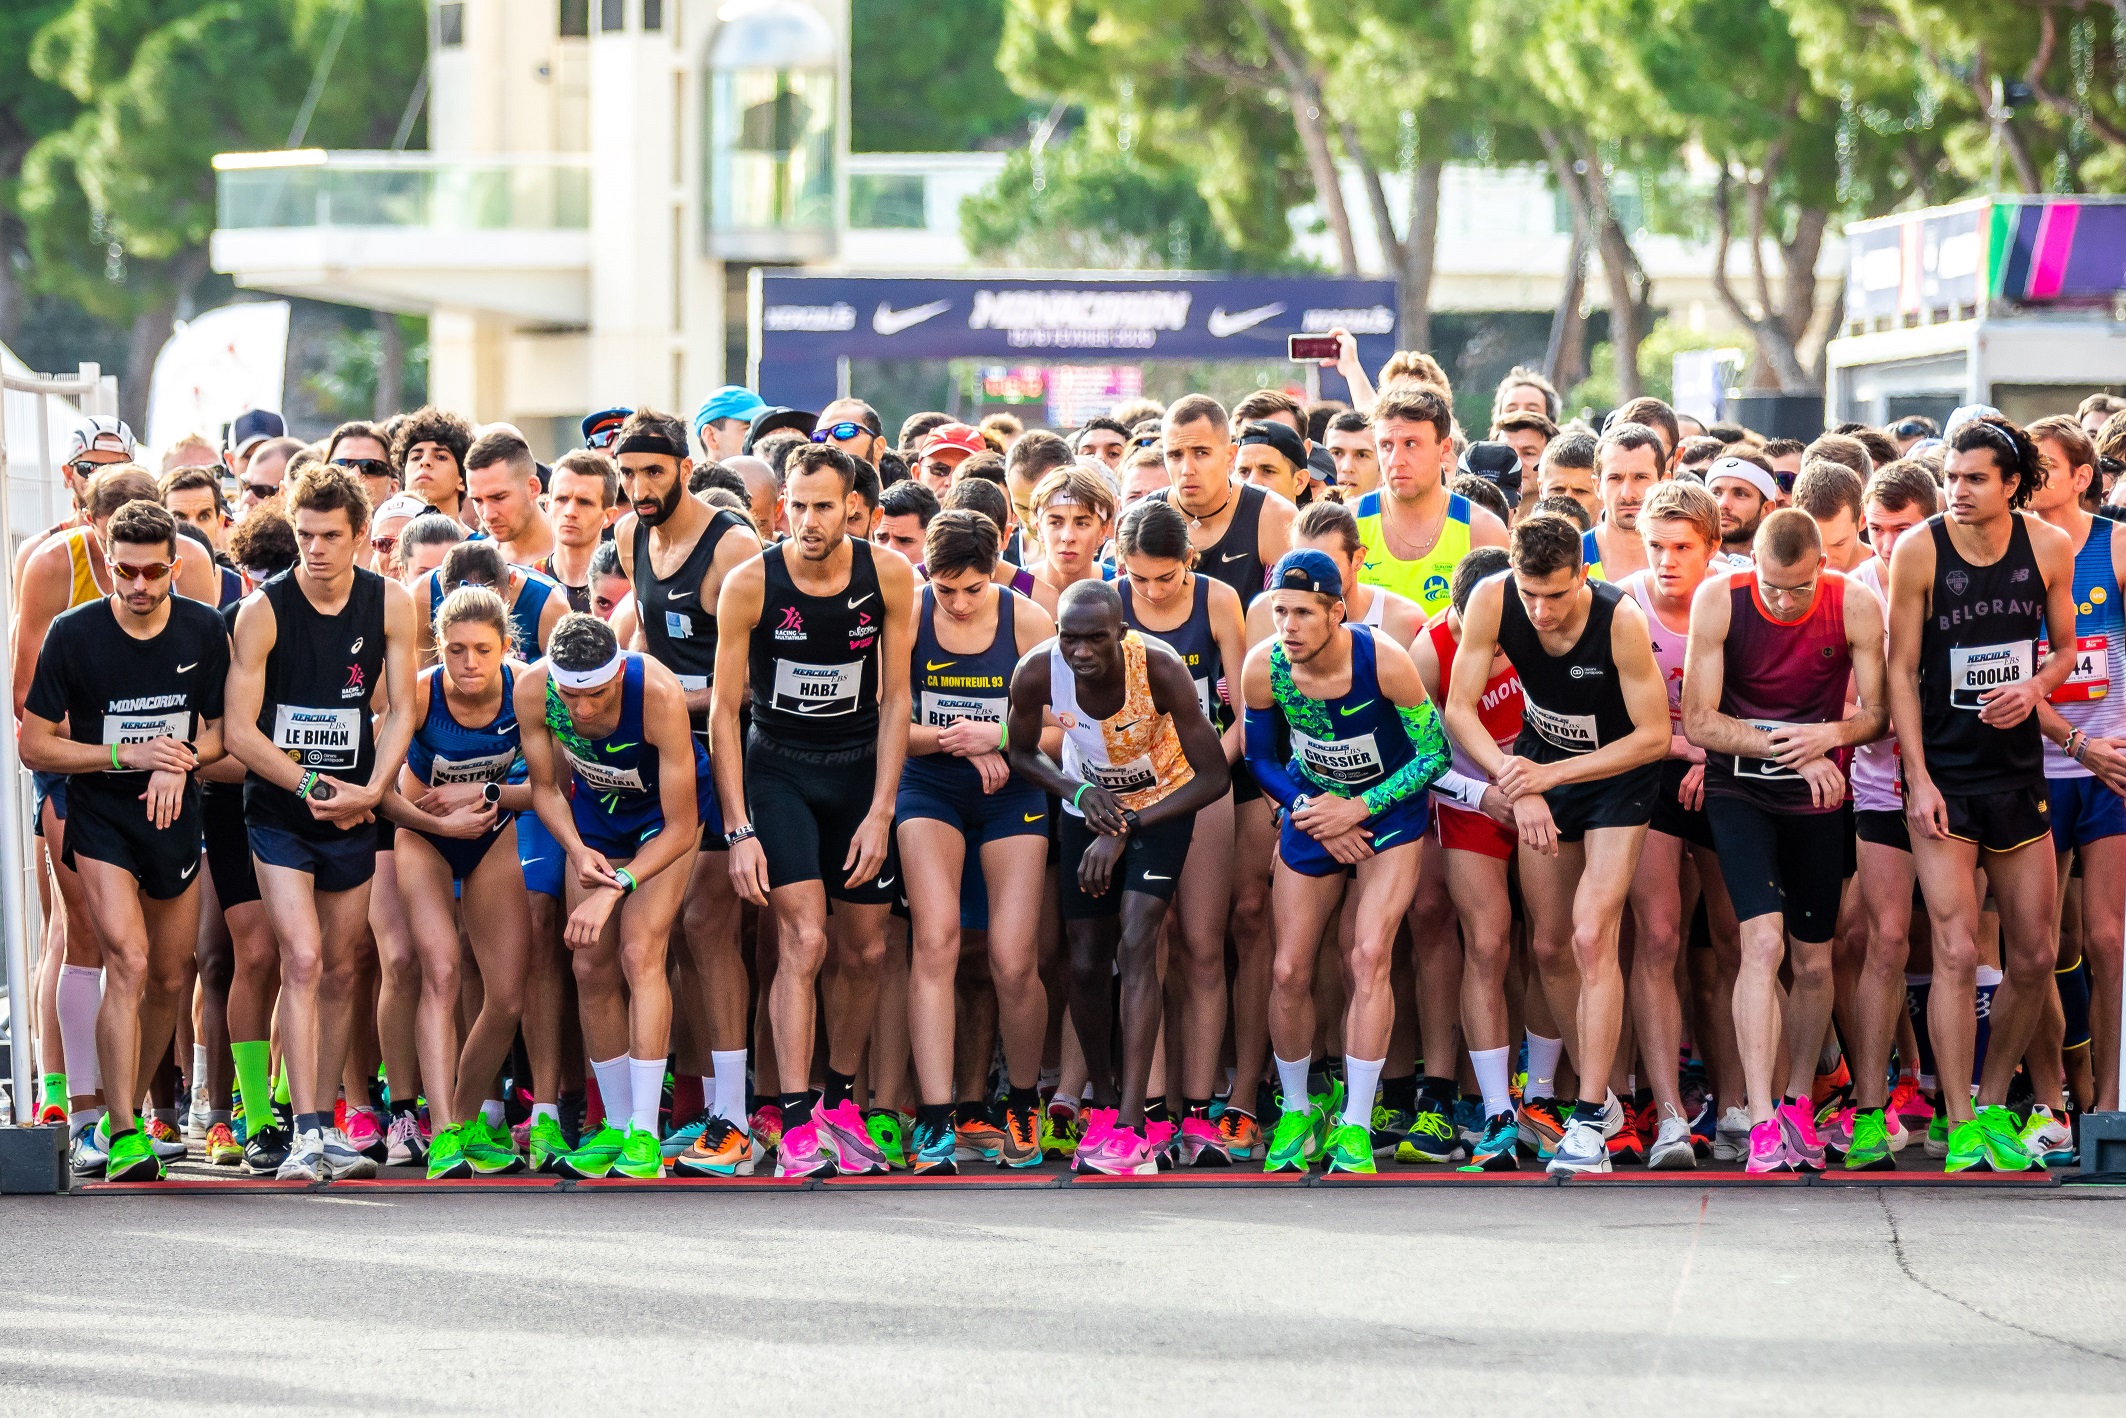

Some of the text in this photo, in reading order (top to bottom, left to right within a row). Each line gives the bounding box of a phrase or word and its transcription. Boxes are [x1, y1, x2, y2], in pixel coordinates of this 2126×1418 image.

[1939, 599, 2043, 630] BELGRAVE
[1189, 654, 1199, 666] 93
[1967, 650, 2011, 664] HERCULIS
[2003, 656, 2020, 665] EBS
[792, 667, 840, 677] HERCULIS
[1966, 665, 2020, 685] GOOLAB
[927, 675, 1003, 688] CA MONTREUIL 93
[800, 682, 839, 697] HABZ
[1481, 676, 1523, 711] MON
[108, 694, 187, 713] MONACORUN
[937, 699, 983, 708] HERCULIS
[291, 712, 337, 722] HERCULIS
[120, 720, 167, 730] HERCULIS
[158, 724, 176, 733] EBS
[329, 721, 347, 730] EBS
[1078, 722, 1091, 730] NN
[285, 728, 349, 746] LE BIHAN
[778, 748, 822, 764] NIKE
[1304, 748, 1371, 768] GRESSIER
